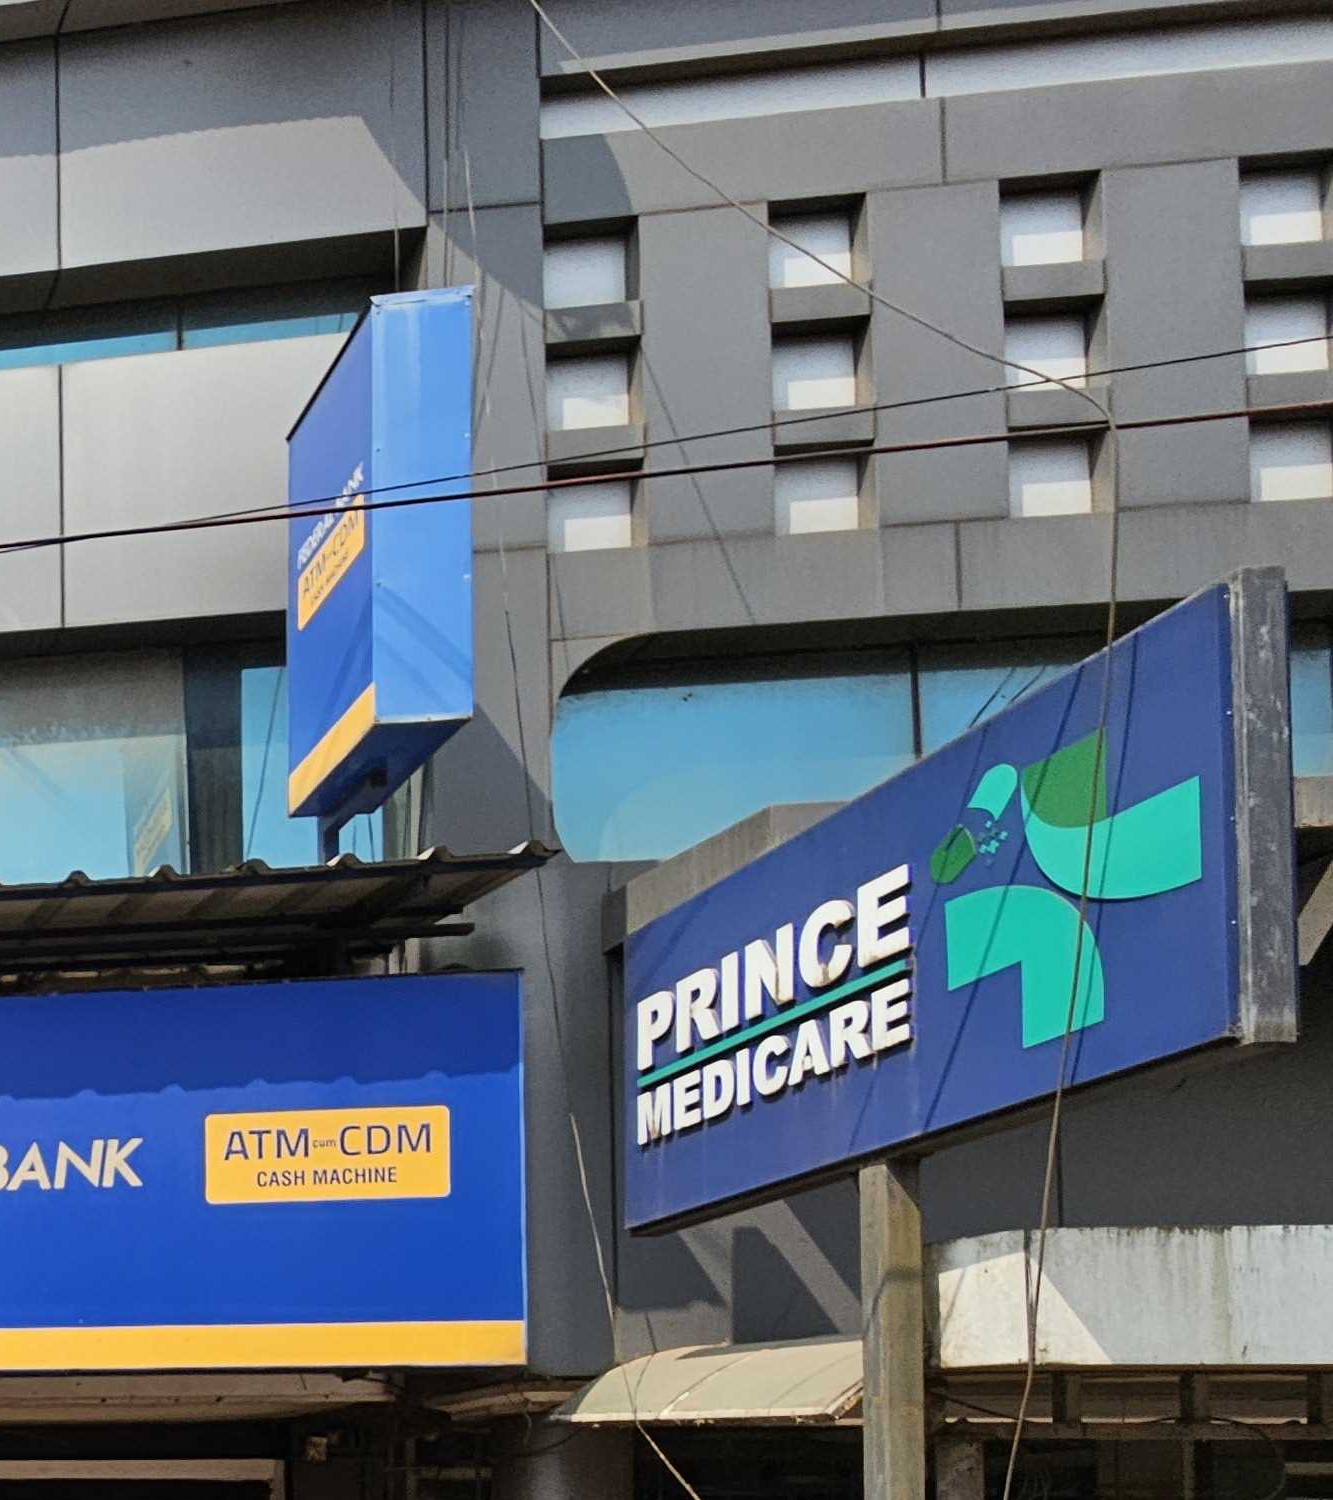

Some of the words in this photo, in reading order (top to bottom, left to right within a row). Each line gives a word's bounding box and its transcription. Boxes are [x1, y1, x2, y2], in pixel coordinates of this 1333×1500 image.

[636, 863, 913, 1071] PRINCE
[636, 978, 913, 1147] MEDICARE
[223, 1126, 312, 1163] ATM
[339, 1121, 433, 1158] CDM
[255, 1168, 305, 1189] CASH
[311, 1164, 398, 1187] MACHINE
